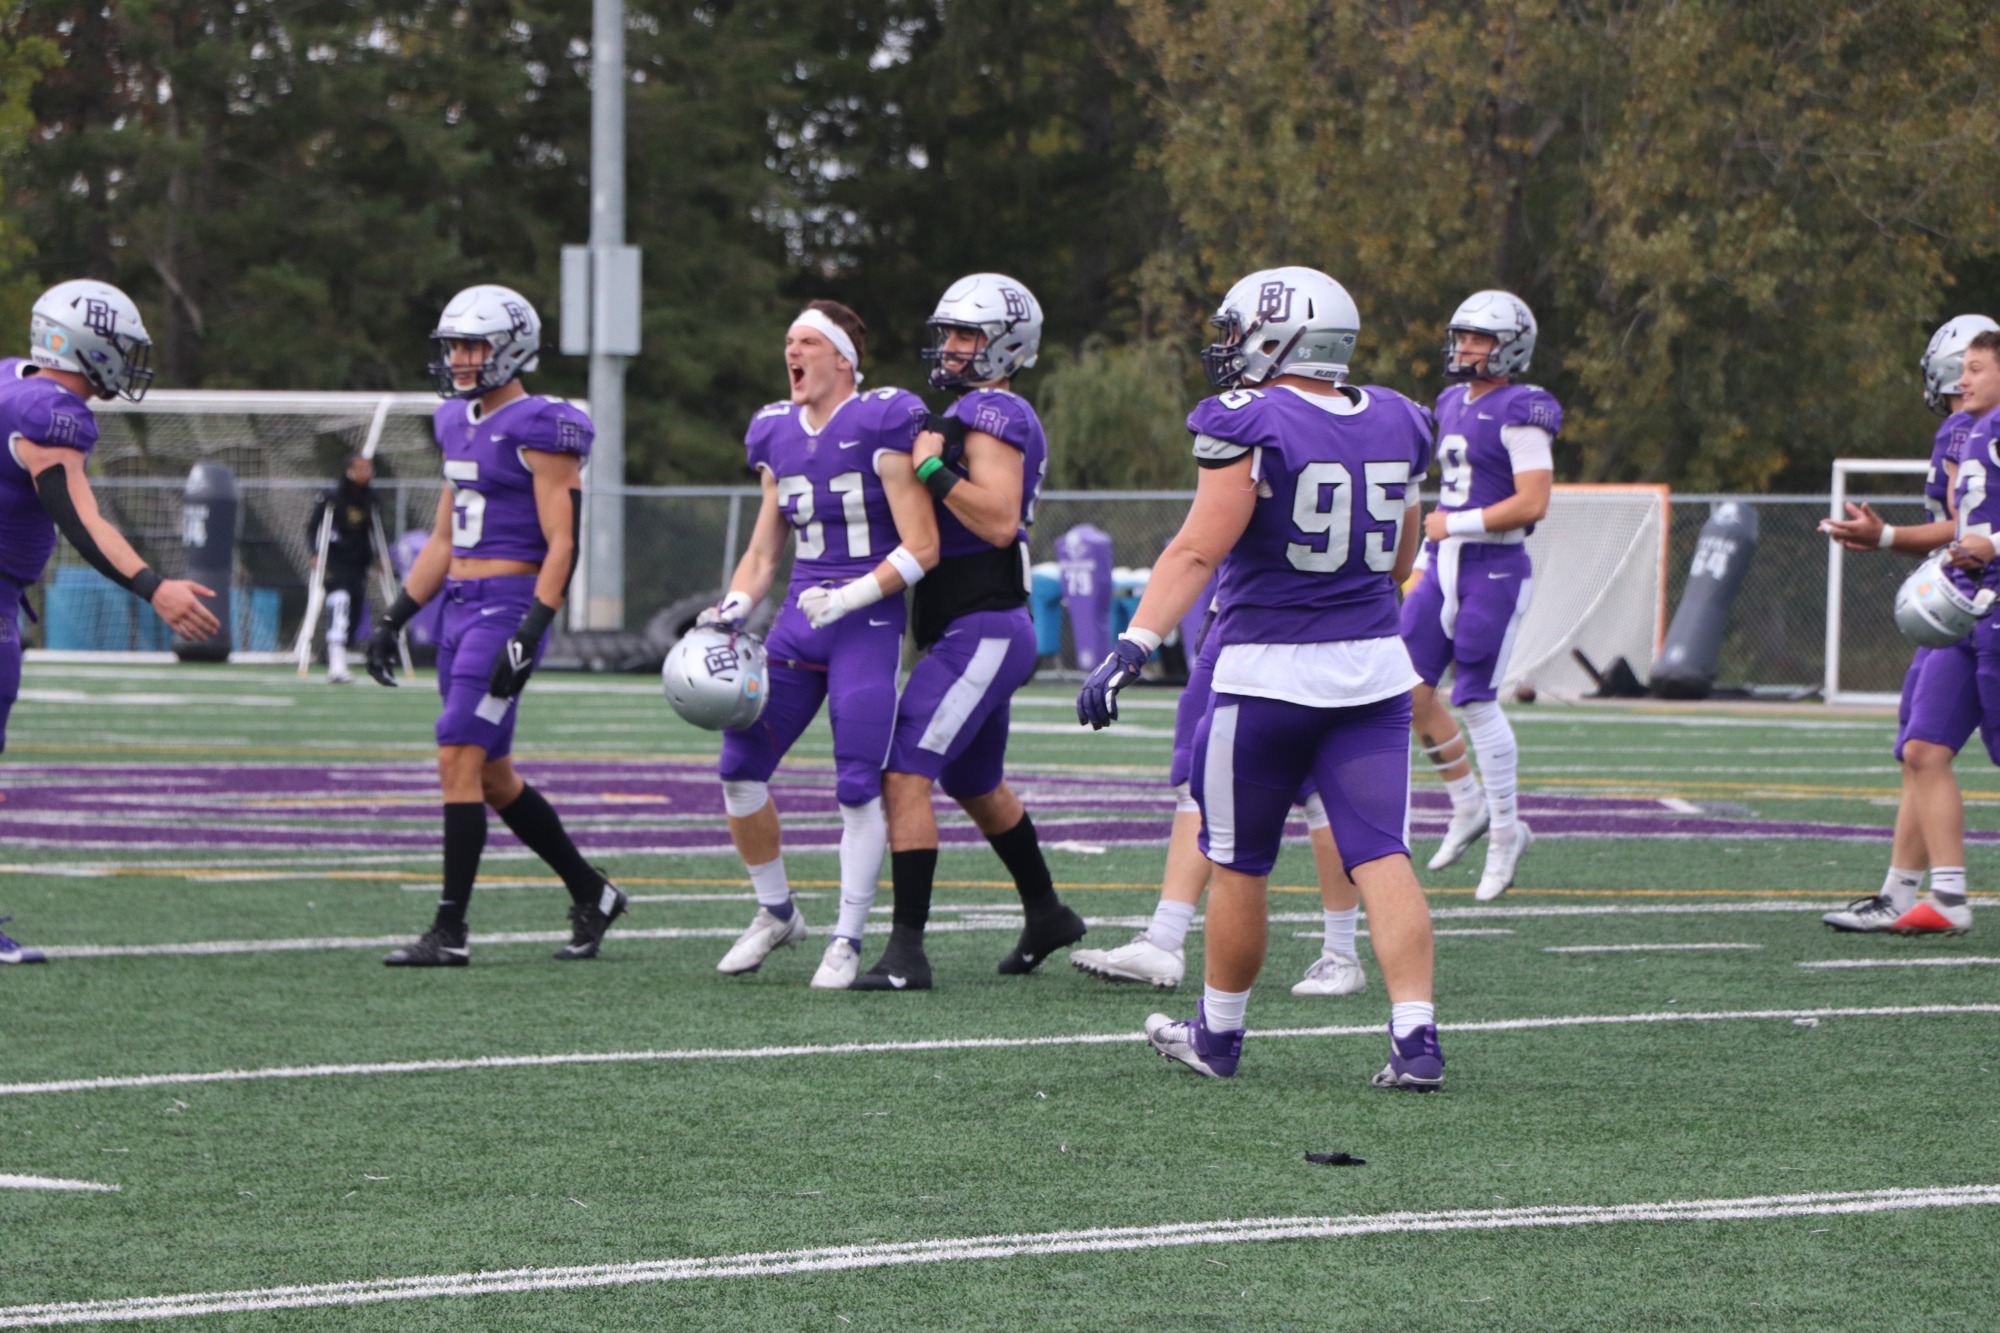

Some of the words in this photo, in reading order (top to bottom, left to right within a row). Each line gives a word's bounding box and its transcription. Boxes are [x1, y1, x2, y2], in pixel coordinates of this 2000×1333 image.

[84, 298, 118, 338] BU
[998, 287, 1031, 323] BU
[1258, 281, 1296, 323] BU
[1297, 346, 1311, 359] 95
[1437, 433, 1473, 508] 9
[443, 460, 487, 549] 5
[777, 472, 872, 560] 31
[1286, 461, 1411, 573] 95
